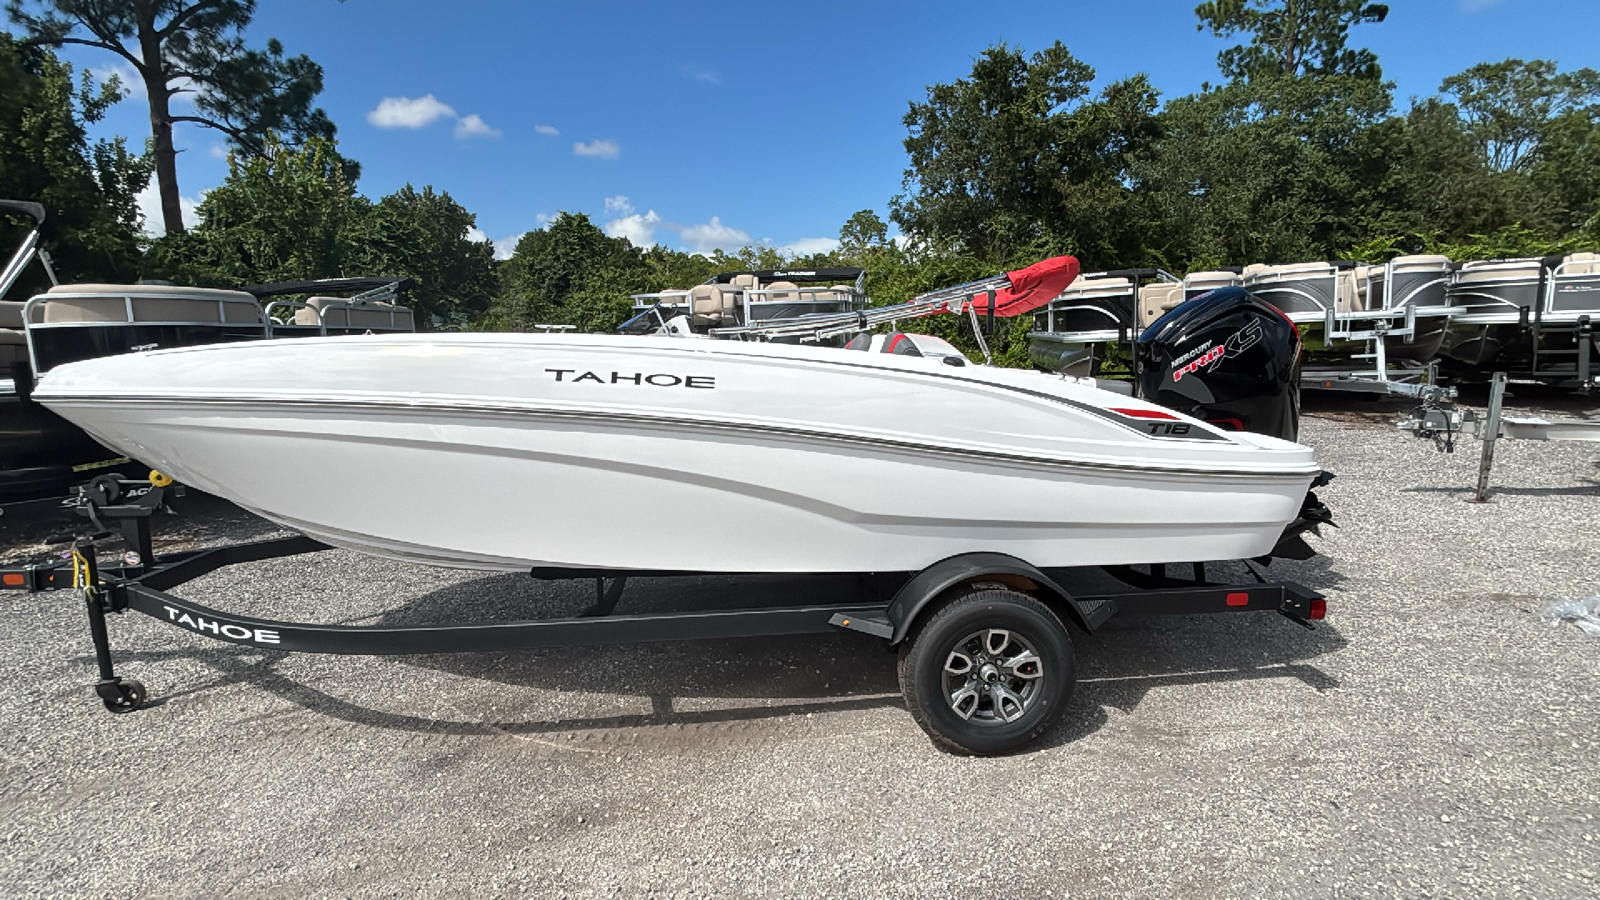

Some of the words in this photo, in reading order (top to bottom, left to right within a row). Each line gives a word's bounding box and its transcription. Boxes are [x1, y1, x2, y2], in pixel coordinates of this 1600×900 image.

[1171, 340, 1212, 368] MERCURY
[545, 368, 716, 389] TAHOE
[1147, 422, 1191, 435] T18
[163, 605, 280, 644] TAHOE
